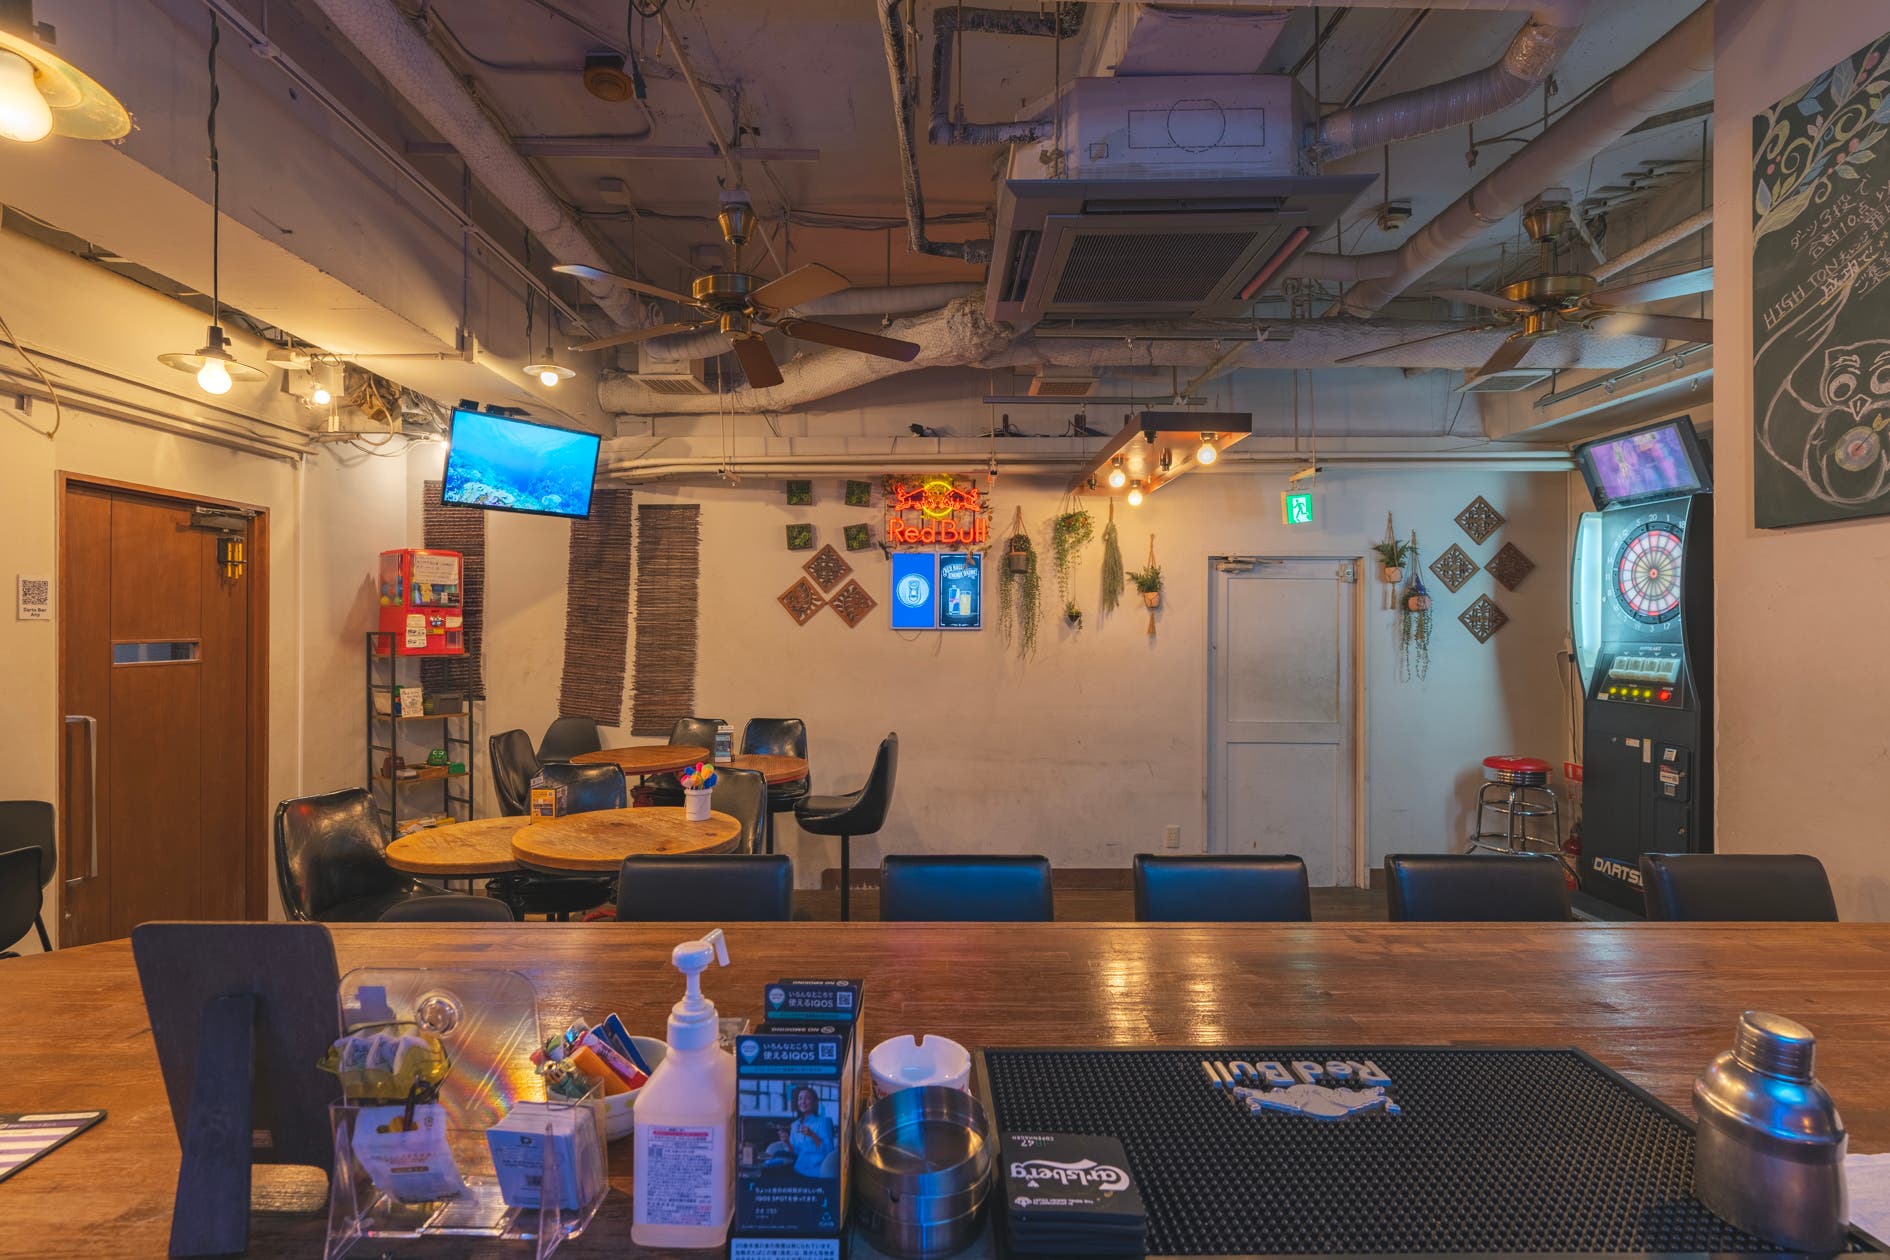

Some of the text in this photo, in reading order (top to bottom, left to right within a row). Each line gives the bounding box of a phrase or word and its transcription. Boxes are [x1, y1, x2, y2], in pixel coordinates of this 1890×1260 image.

[1763, 285, 1806, 331] HIGH
[1807, 255, 1842, 288] TON
[888, 517, 987, 544] Red Bull
[1648, 513, 1658, 521] 20
[788, 999, 834, 1008] 使えるIQOS
[763, 1052, 815, 1061] 使えるIQOS
[1201, 1060, 1392, 1088] Red Bull
[1010, 1158, 1130, 1191] Carlsberg
